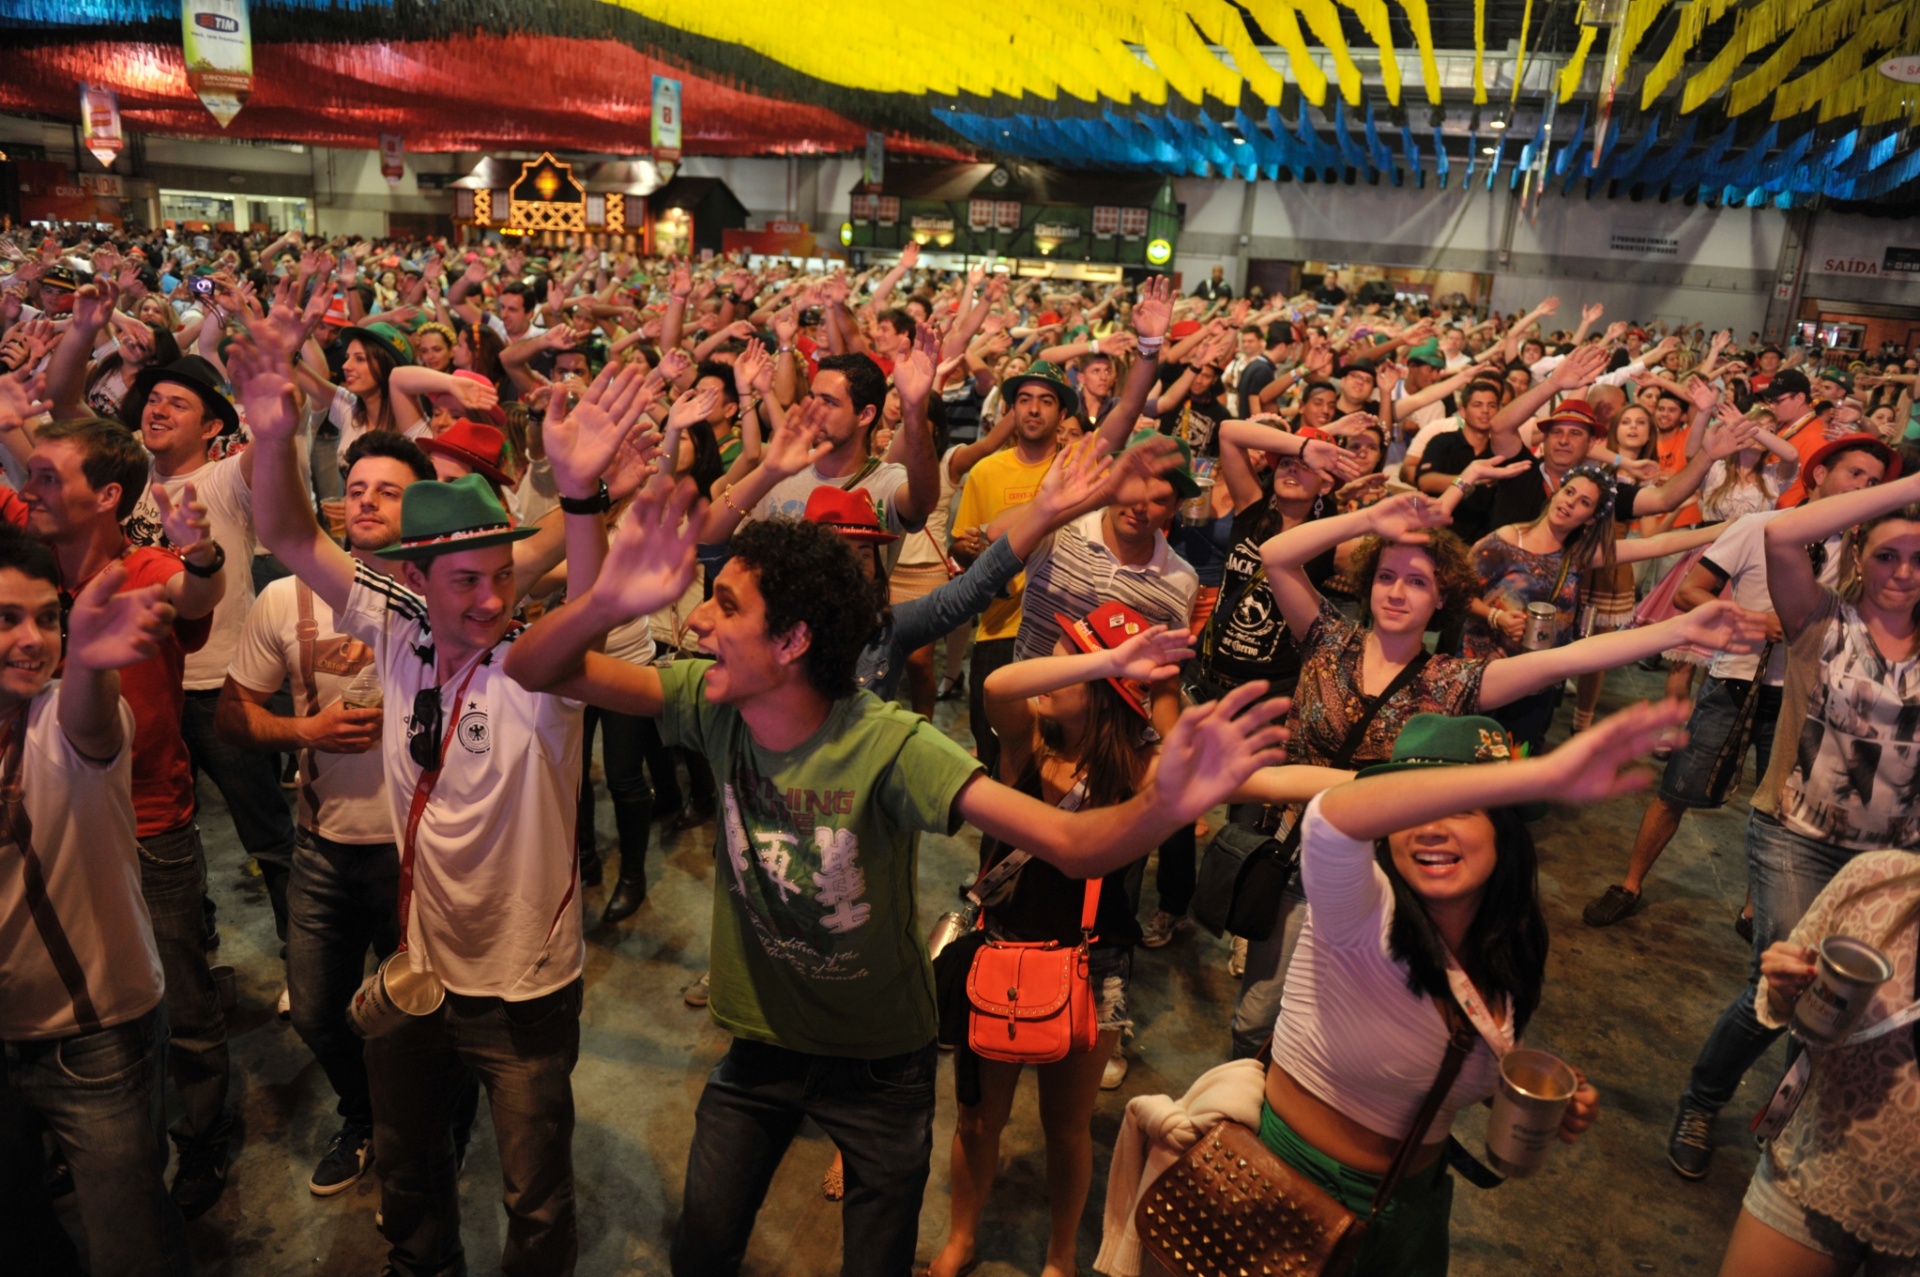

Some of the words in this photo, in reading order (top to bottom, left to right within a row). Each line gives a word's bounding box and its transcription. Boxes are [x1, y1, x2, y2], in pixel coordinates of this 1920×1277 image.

[214, 17, 235, 31] TIM
[55, 186, 85, 198] CAIXA
[1824, 257, 1878, 274] SAÍDA
[1778, 287, 1790, 297] H
[1226, 552, 1257, 576] JACK
